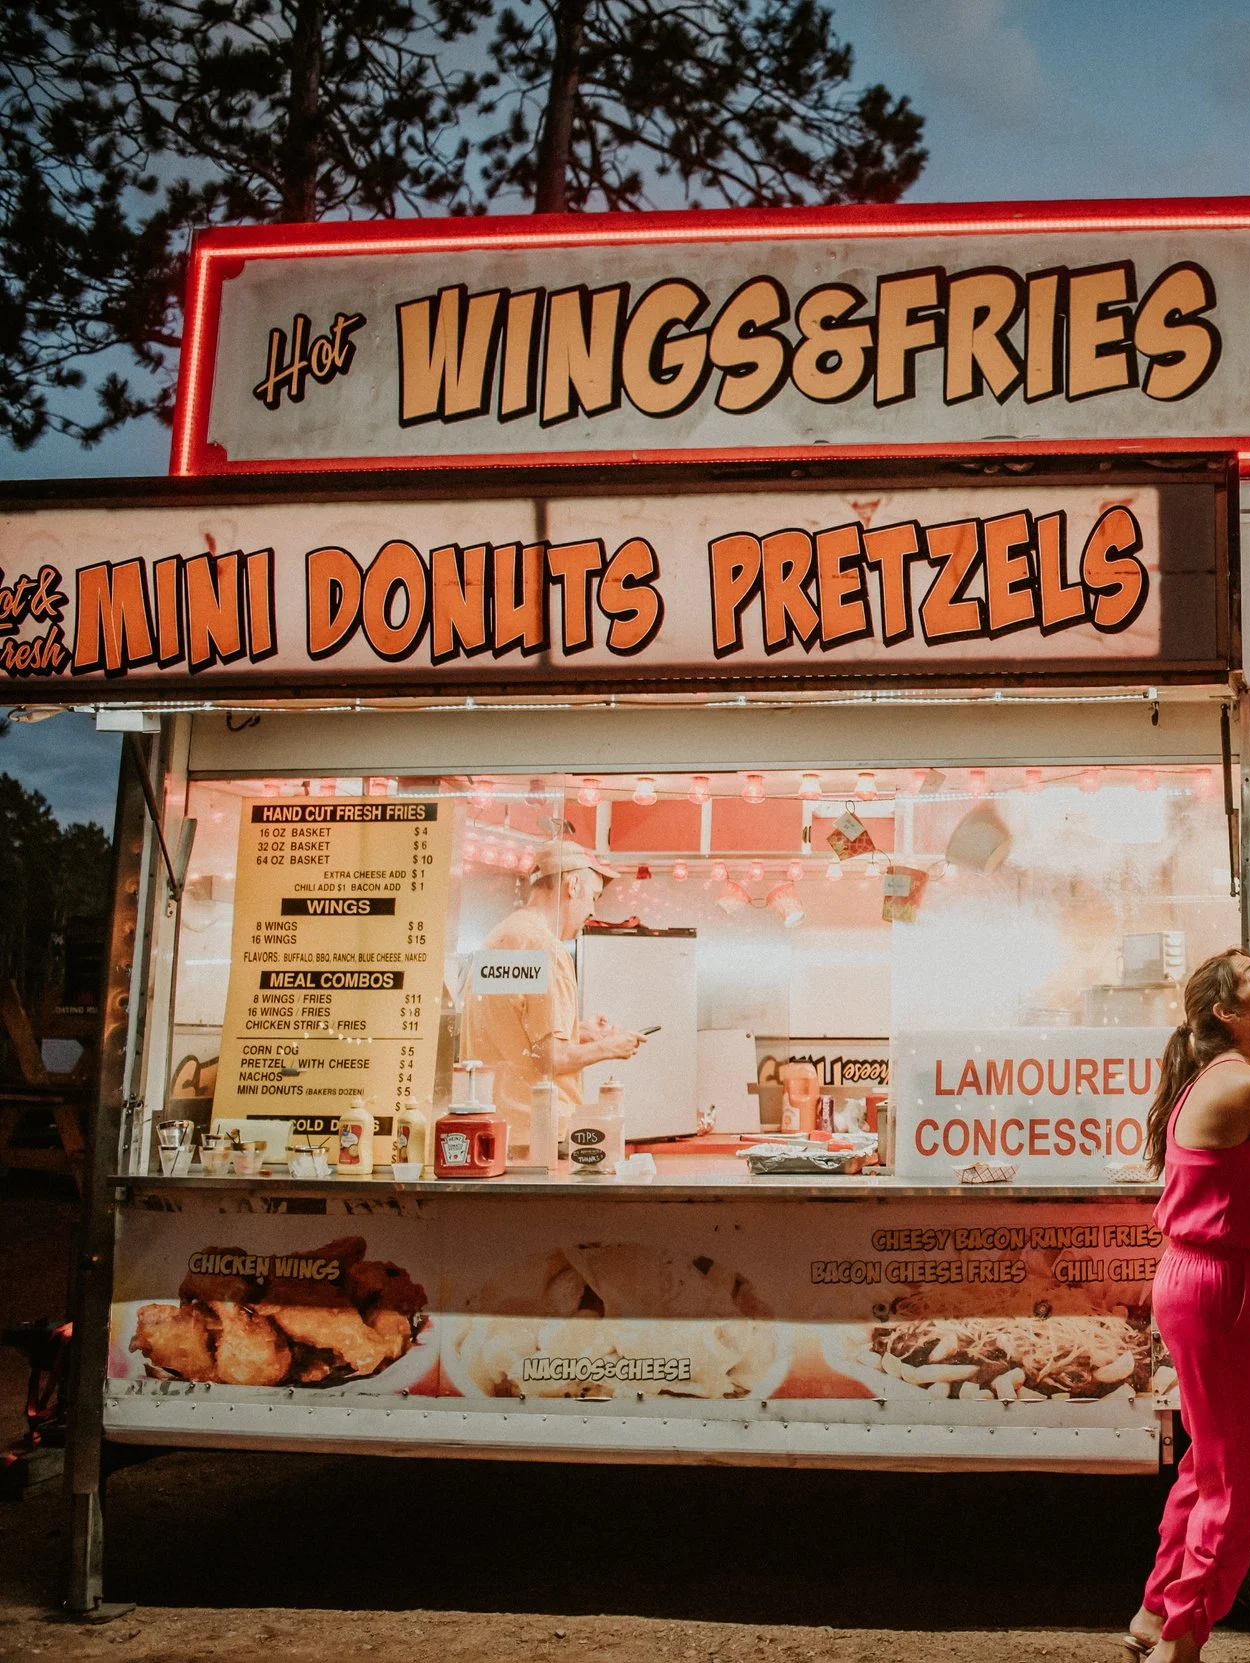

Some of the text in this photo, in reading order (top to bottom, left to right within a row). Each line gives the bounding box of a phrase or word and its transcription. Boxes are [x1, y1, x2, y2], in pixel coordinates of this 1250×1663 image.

[253, 313, 367, 410] Hot
[71, 505, 1149, 679] MINI DONUTS PRETZELS
[0, 622, 73, 677] resh
[263, 805, 426, 821] HAND CUT FRESH FRIES
[260, 828, 269, 837] 16
[273, 828, 286, 837] OZ
[292, 828, 332, 837] BASKET
[258, 842, 268, 851] 32
[271, 842, 285, 851] OZ
[291, 842, 330, 851] BASKET
[256, 856, 268, 865] 64
[271, 856, 284, 864] OZ
[290, 855, 330, 864] BASKET
[324, 871, 351, 879] EXTRA
[353, 871, 386, 879] CHEESE
[294, 884, 316, 892] CHILI
[384, 883, 401, 891] ADD
[307, 900, 371, 914] WINGS
[256, 922, 261, 930] 8
[265, 922, 298, 931] WINGS
[252, 936, 261, 944] 16
[264, 935, 297, 944] WINGS
[244, 952, 280, 963] FLAVORS:
[359, 954, 375, 962] BLUE
[405, 954, 426, 962] NAKED
[481, 966, 541, 979] CASH ONLY
[270, 972, 394, 988] MEAL COMBOS
[253, 994, 259, 1003] 8
[262, 994, 295, 1004] WINGS
[303, 994, 332, 1003] FRIES
[248, 1008, 257, 1017] 16
[260, 1008, 293, 1017] WINGS
[301, 1008, 330, 1017] FRIES
[246, 1021, 290, 1030] CHICKEN
[293, 1021, 329, 1030] STRIPS
[338, 1021, 367, 1030] FRIES
[243, 1046, 272, 1055] CORN
[277, 1045, 299, 1055] DOG
[241, 1059, 286, 1068] PRETZEL
[299, 1059, 324, 1068] WITH
[329, 1059, 370, 1068] CHEESE
[239, 1072, 283, 1081] NACHOS
[237, 1086, 258, 1095] MINI
[261, 1086, 303, 1095] DONUTS
[575, 1131, 598, 1143] TIPS
[915, 1118, 1143, 1156] CONCESSIO
[872, 1224, 1163, 1251] CHEESY BACON RANCH FRIES
[188, 1252, 340, 1280] CHICKEN WINGS
[811, 1258, 1160, 1284] BACON CHEESE FRIES CHILI CHEE
